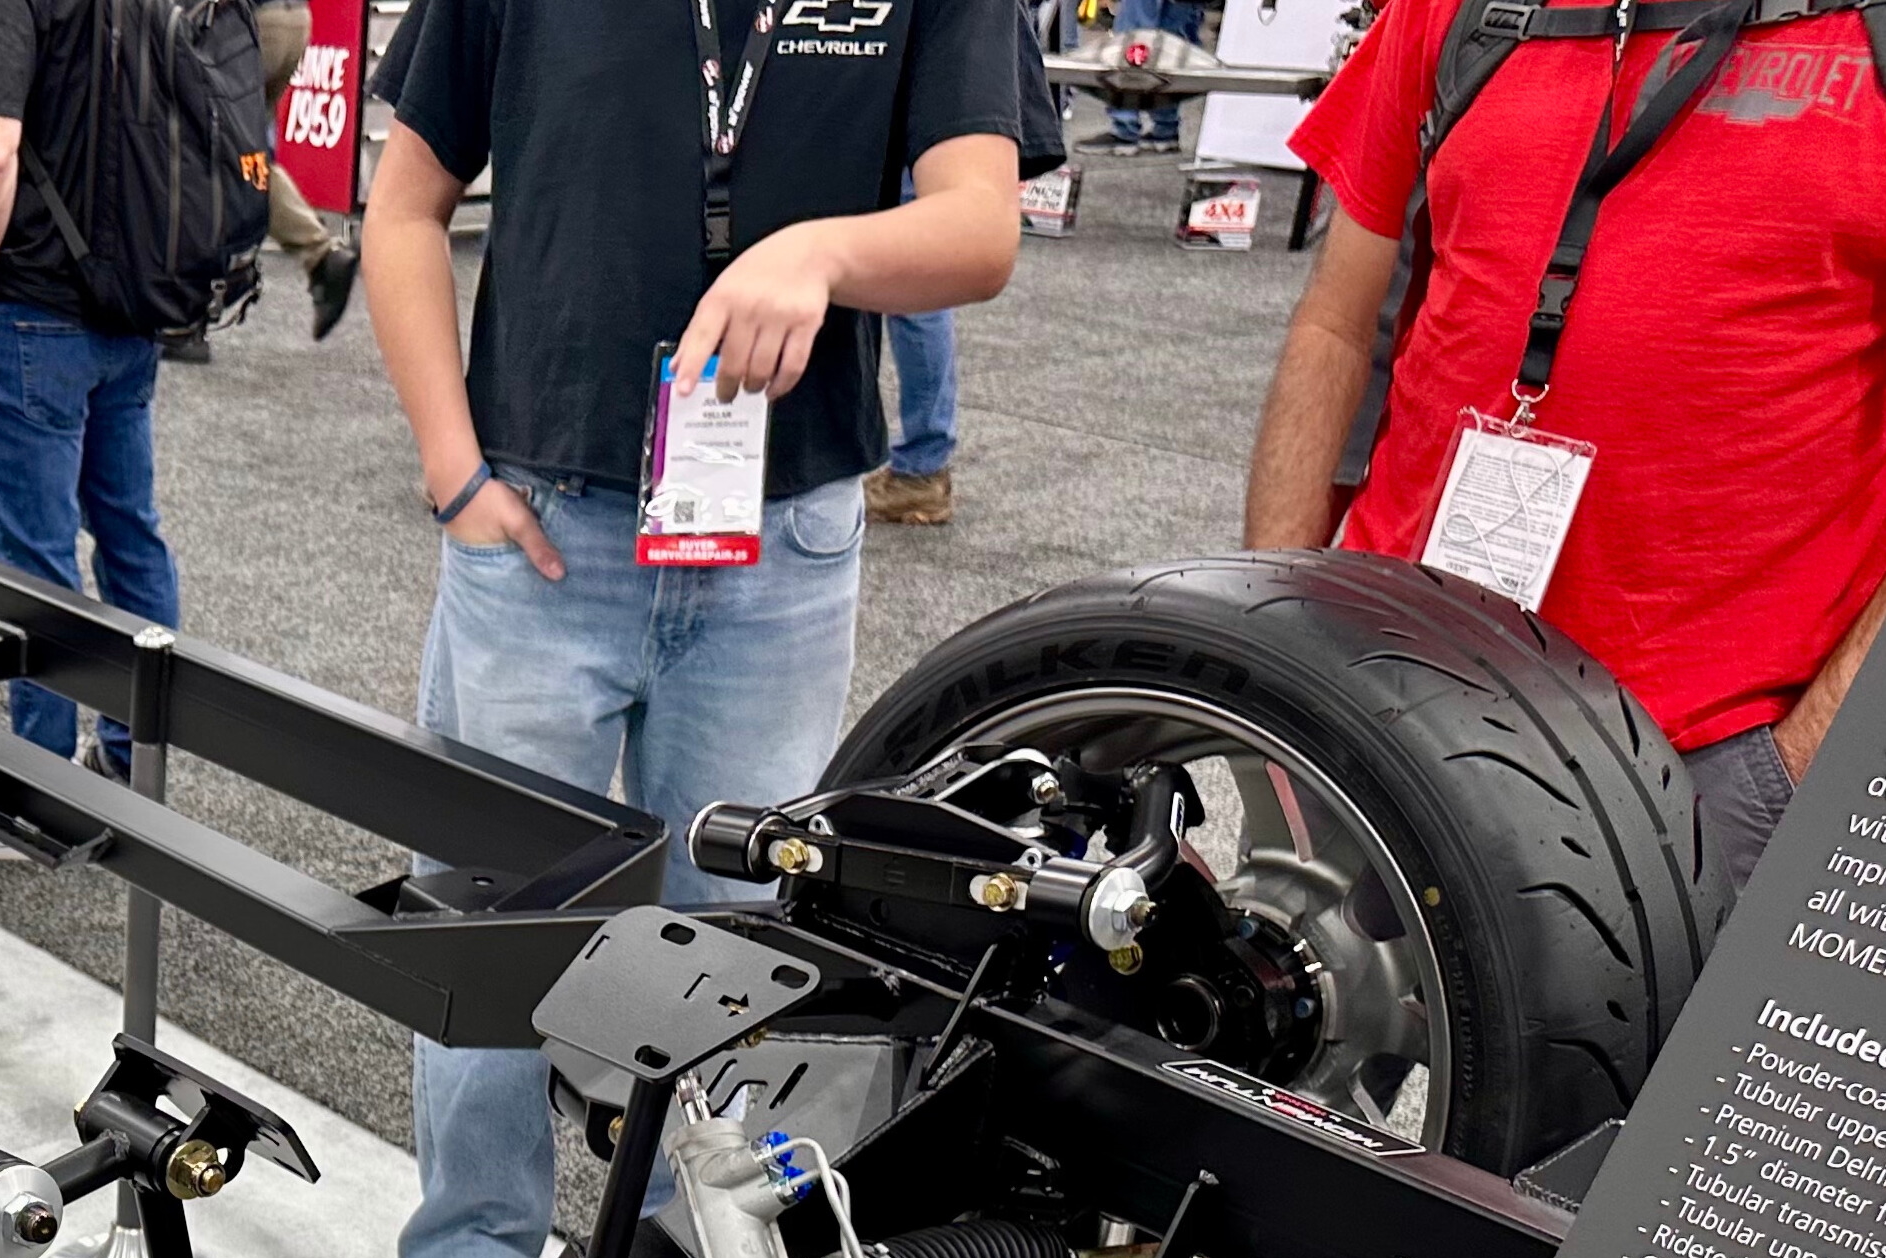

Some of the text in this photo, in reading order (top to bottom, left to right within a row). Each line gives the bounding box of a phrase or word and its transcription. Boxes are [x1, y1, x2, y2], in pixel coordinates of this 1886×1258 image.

[776, 39, 888, 56] CHEVROLET
[285, 87, 347, 149] 1959
[1807, 888, 1846, 915] all
[1734, 1072, 1824, 1122] Tubular
[1714, 1103, 1822, 1161] Premium
[1686, 1163, 1775, 1214] Tubular
[1760, 1159, 1873, 1215] diameter
[1678, 1196, 1766, 1248] Tubular
